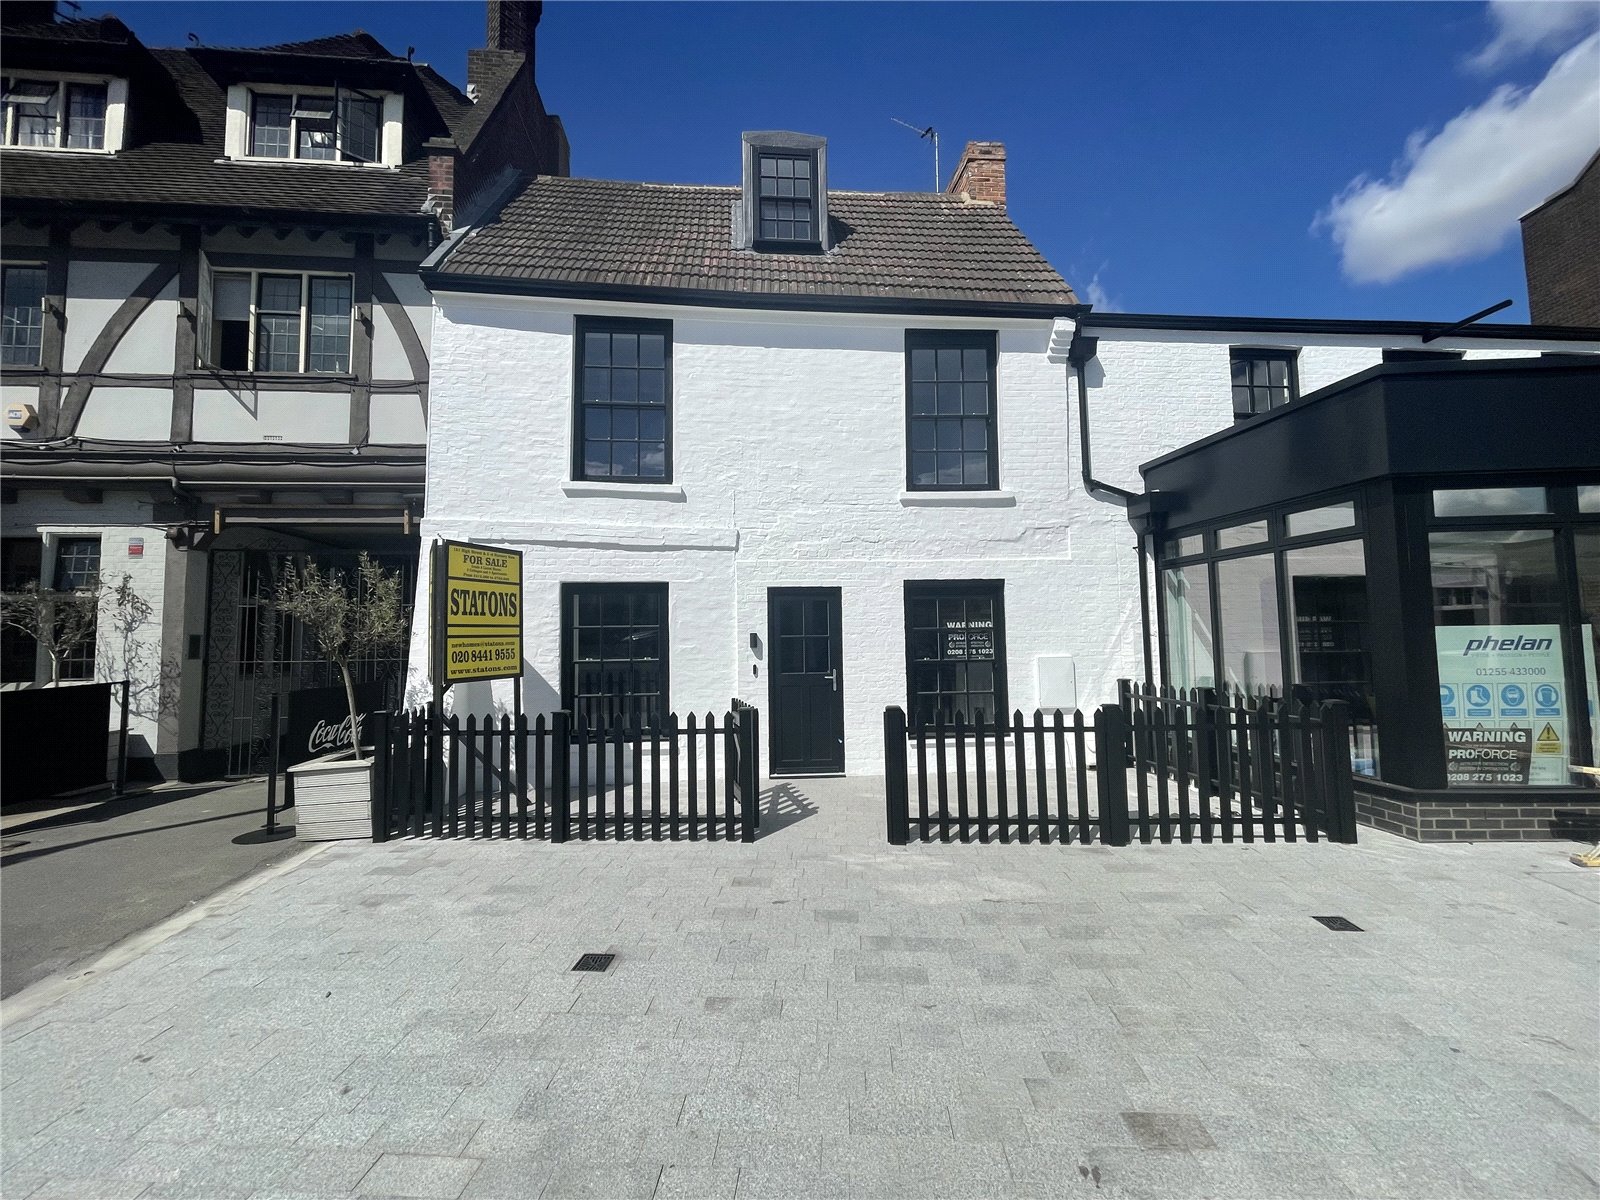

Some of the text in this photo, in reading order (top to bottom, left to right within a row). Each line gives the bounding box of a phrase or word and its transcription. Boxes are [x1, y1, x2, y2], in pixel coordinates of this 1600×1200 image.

[463, 554, 508, 568] FOR SALE
[450, 588, 517, 617] STATONS
[1463, 635, 1552, 656] phelan
[452, 648, 515, 663] 020 8441 9555
[450, 665, 517, 675] www.statons.com
[1448, 731, 1526, 742] WARNING
[1448, 749, 1517, 759] PROFORCE
